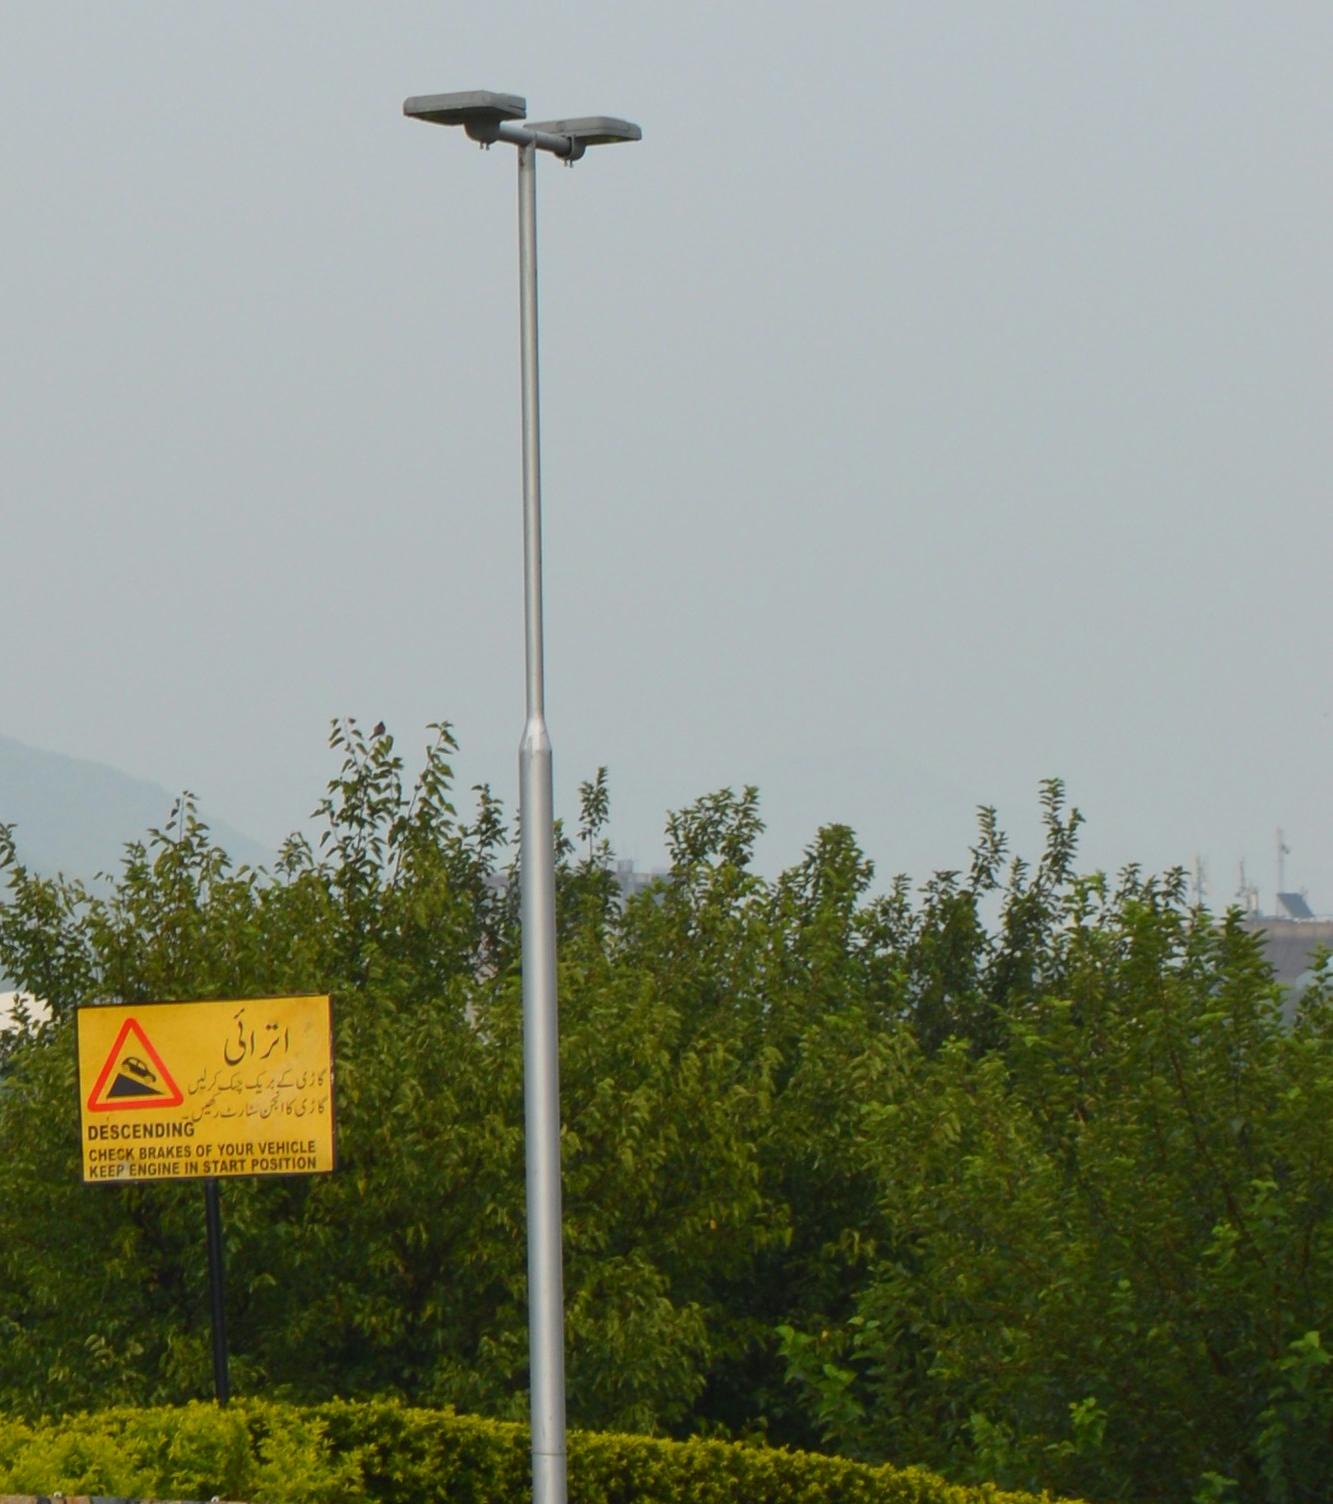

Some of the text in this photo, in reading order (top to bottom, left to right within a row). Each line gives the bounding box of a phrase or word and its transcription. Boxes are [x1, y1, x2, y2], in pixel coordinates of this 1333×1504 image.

[277, 1069, 294, 1088] کے
[296, 1068, 327, 1089] گاڑی
[295, 1095, 328, 1117] گاڑی
[88, 1122, 195, 1140] DESCENDING
[89, 1140, 316, 1162] CHECK BRAKES OF YOUR VEHICLE
[89, 1157, 317, 1179] KEEP ENGINE IN START POSITION
